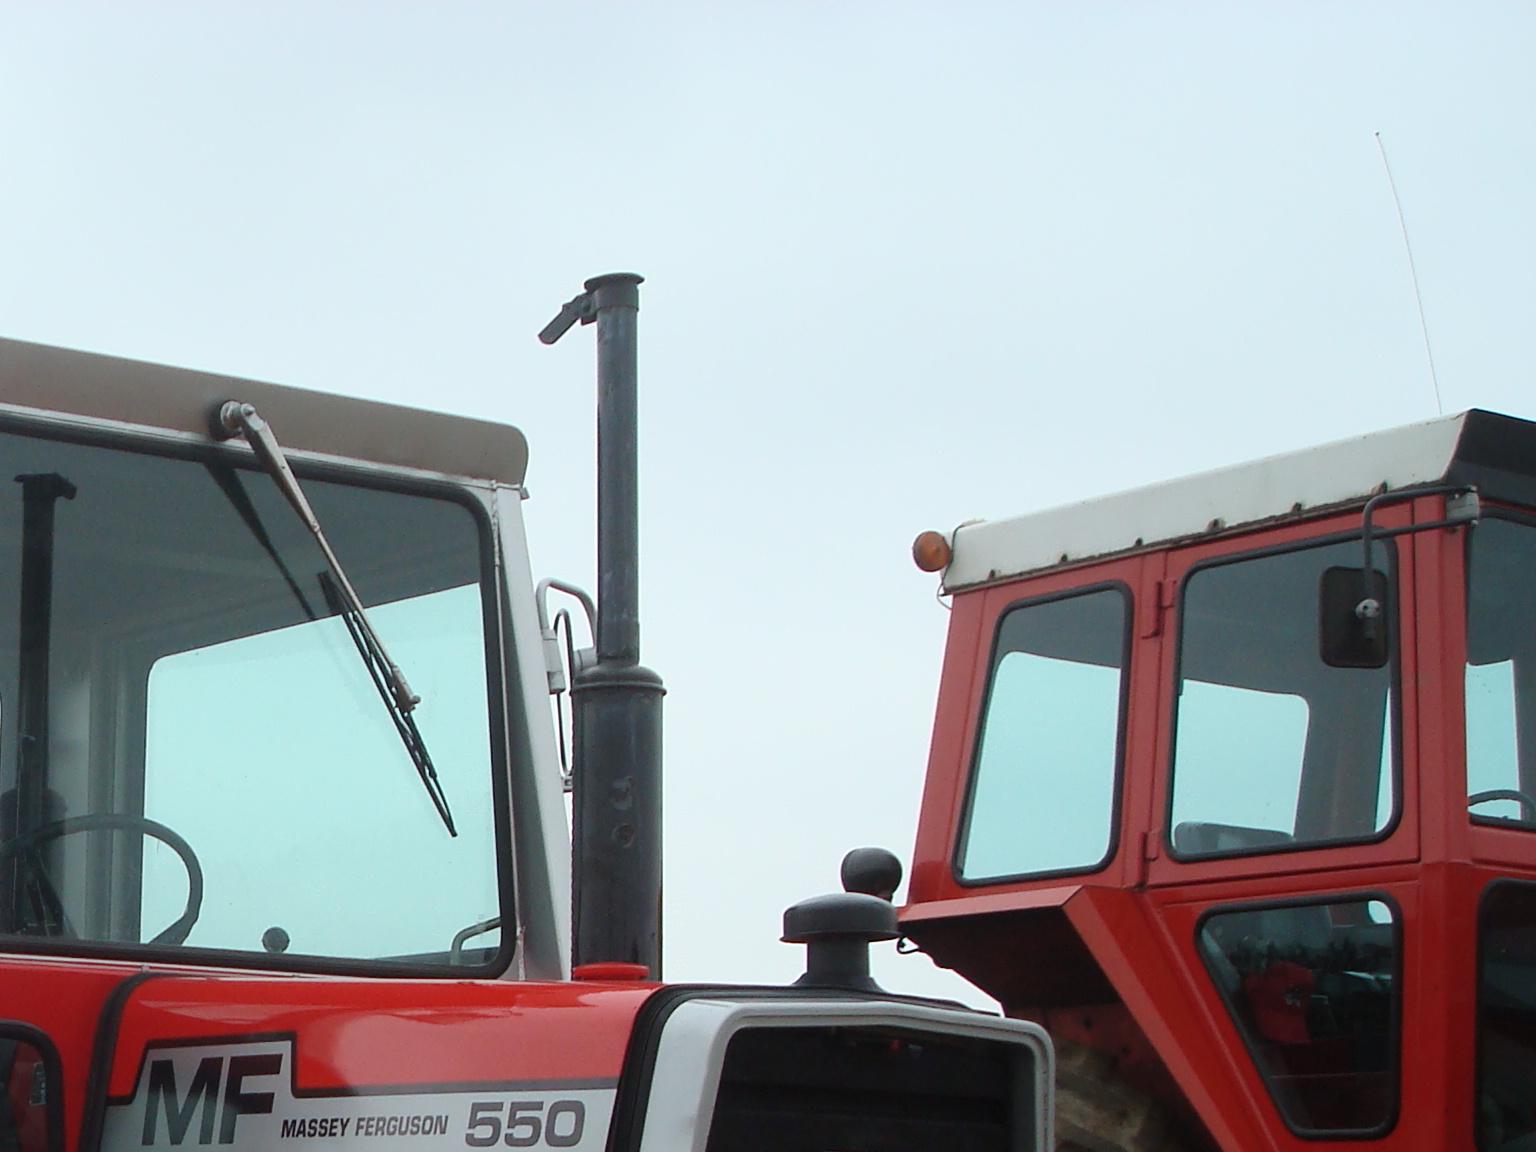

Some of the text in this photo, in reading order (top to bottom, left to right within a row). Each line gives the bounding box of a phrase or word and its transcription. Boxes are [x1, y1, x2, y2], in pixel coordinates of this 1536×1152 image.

[141, 1054, 283, 1146] MF
[280, 1100, 586, 1147] MASSEY FERGUSON 550
